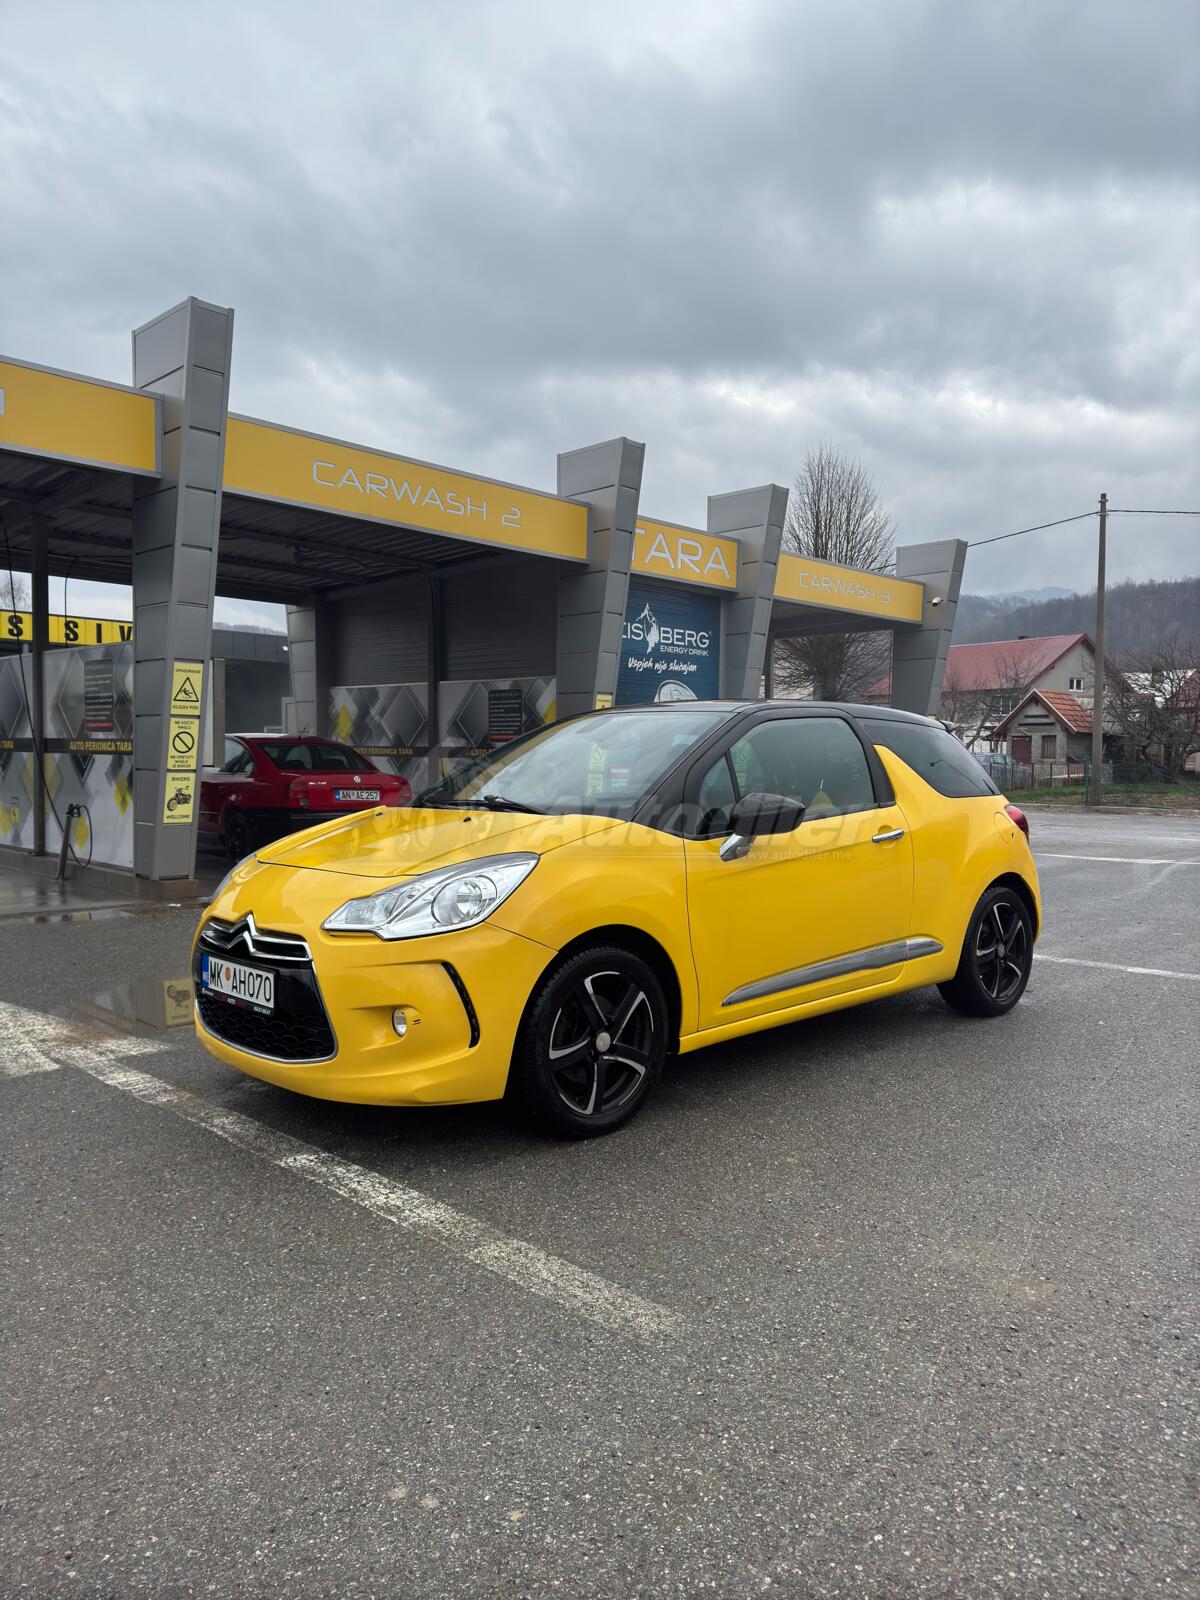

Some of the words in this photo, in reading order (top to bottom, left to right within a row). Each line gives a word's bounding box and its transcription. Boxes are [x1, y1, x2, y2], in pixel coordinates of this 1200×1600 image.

[313, 461, 487, 520] CARWASH
[501, 506, 521, 528] 2
[799, 571, 877, 601] CARWASH
[660, 645, 687, 655] ENERGY
[688, 648, 709, 657] DRINK
[628, 657, 653, 671] Uspjeh
[654, 660, 667, 674] nije
[70, 741, 84, 751] AUTO
[117, 742, 133, 752] TARA
[341, 791, 351, 800] AN
[356, 791, 379, 800] AE257
[209, 960, 223, 989] MK
[231, 967, 272, 1003] AH070
